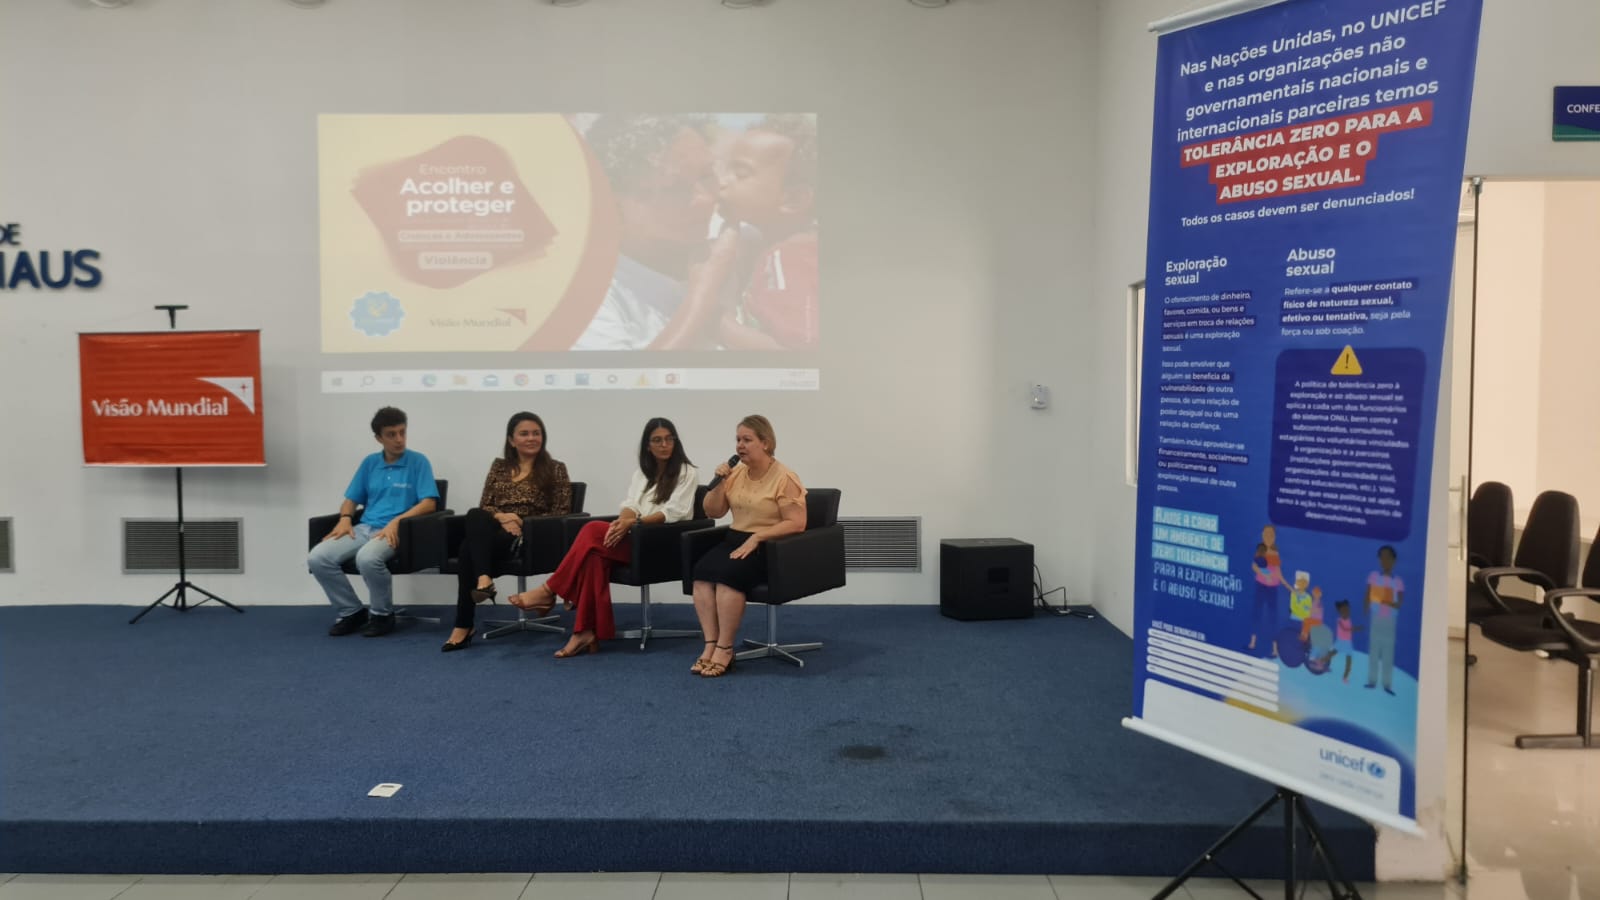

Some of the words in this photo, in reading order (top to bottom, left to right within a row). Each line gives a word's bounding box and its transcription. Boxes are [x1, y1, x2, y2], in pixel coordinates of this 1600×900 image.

[1180, 62, 1206, 77] Nas
[1210, 45, 1267, 71] Nações
[1272, 29, 1336, 54] Unidas,
[1341, 21, 1365, 38] no
[1370, 0, 1447, 30] UNICEF
[1204, 80, 1214, 93] e
[1217, 74, 1245, 90] nas
[1248, 44, 1363, 83] organizações
[1369, 36, 1406, 56] não
[1186, 78, 1315, 121] governamentais
[1319, 57, 1410, 90] nacionais
[1416, 56, 1428, 70] e
[1177, 109, 1283, 142] internacionais
[1288, 91, 1370, 124] parceiras
[1376, 80, 1439, 103] temos
[1567, 104, 1600, 113] CONFE
[1184, 131, 1285, 162] TOLERÂNCIA
[1289, 121, 1339, 144] ZERO
[1345, 110, 1401, 134] PARA
[1406, 106, 1423, 123] A
[1216, 146, 1334, 178] EXPLORAÇÃO
[1339, 144, 1351, 158] E
[1356, 140, 1372, 156] O
[418, 164, 488, 176] Encontro
[400, 178, 494, 195] Acolher
[500, 181, 515, 194] e
[1220, 178, 1278, 200] ABUSO
[1282, 168, 1361, 191] SEXUAL.
[406, 196, 516, 217] proteger
[1182, 214, 1209, 227] Todos
[1210, 214, 1223, 224] os
[1224, 209, 1255, 222] casos
[1257, 203, 1297, 219] devem
[1300, 200, 1320, 213] ser
[1322, 188, 1415, 210] denunciados!
[425, 254, 487, 265] Violência
[1286, 248, 1336, 262] Abuso
[0, 249, 103, 289] AUS
[1166, 256, 1228, 274] Exploração
[1286, 261, 1335, 277] sexual
[1165, 272, 1199, 286] sexual
[1332, 283, 1373, 294] qualquer
[1375, 281, 1412, 290] contato
[1284, 300, 1305, 309] físico
[1306, 300, 1318, 308] de
[1320, 299, 1359, 308] natureza
[1361, 296, 1394, 306] sexual,
[1282, 312, 1311, 322] efetivo
[1326, 311, 1369, 321] tentativa,
[1316, 327, 1331, 335] sob
[91, 398, 143, 417] Visão
[146, 396, 228, 417] Mundial
[1152, 578, 1159, 592] E
[1153, 562, 1176, 578] PARA
[1177, 567, 1184, 580] A
[1185, 568, 1243, 593] EXPLORAÇÃO
[1320, 748, 1365, 773] unicef
